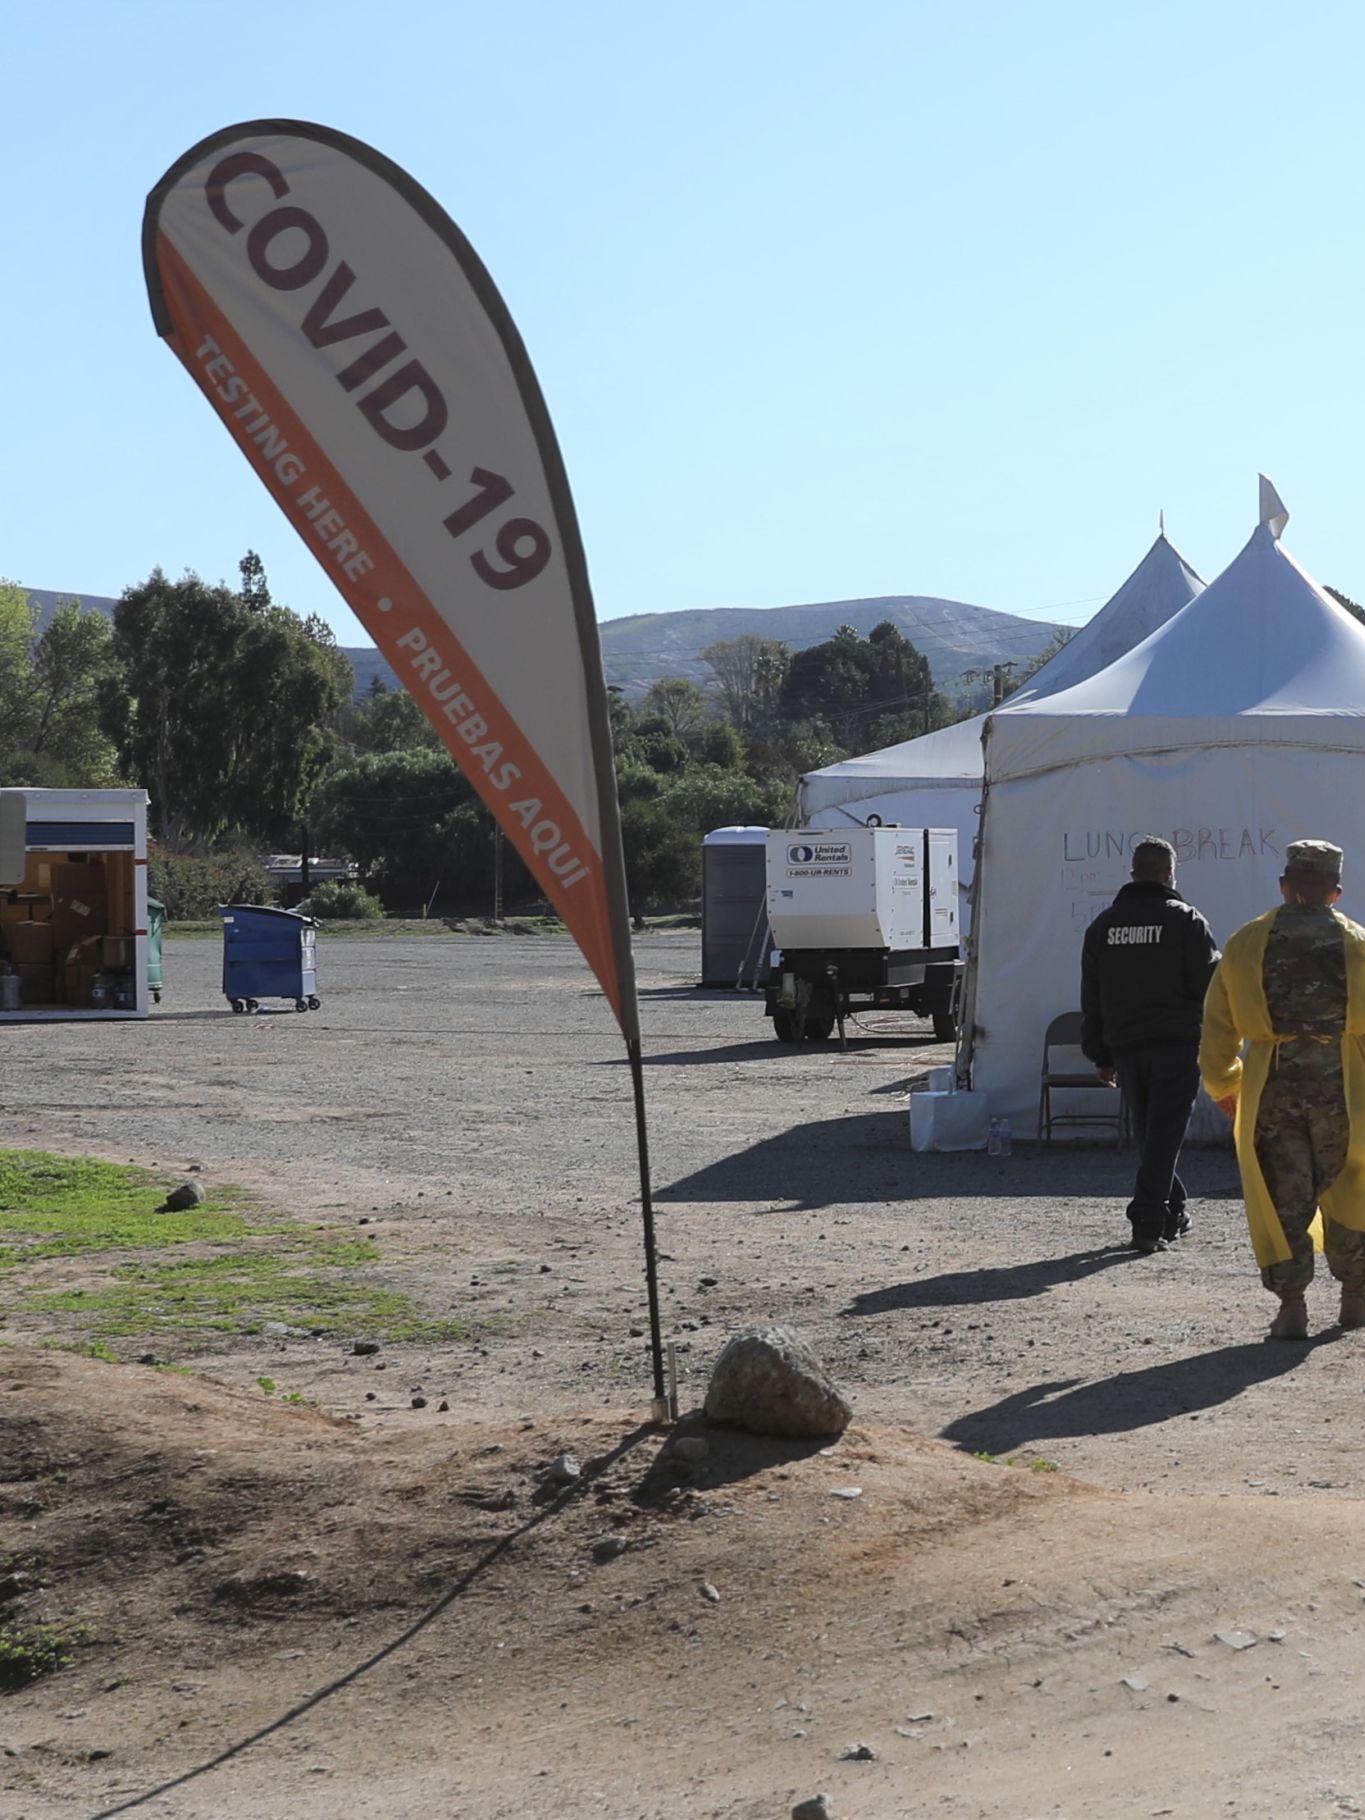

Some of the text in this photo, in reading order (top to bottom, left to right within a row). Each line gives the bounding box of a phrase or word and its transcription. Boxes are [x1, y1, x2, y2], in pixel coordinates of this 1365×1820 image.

[204, 151, 552, 590] COVID-19
[196, 334, 307, 486] TESTING
[297, 485, 375, 582] HERE
[396, 627, 522, 790] PRUEBAS
[814, 846, 846, 854] United
[814, 854, 848, 862] Rentals
[1063, 828, 1280, 862] LUNC BREAK
[1107, 925, 1163, 945] SECURITY
